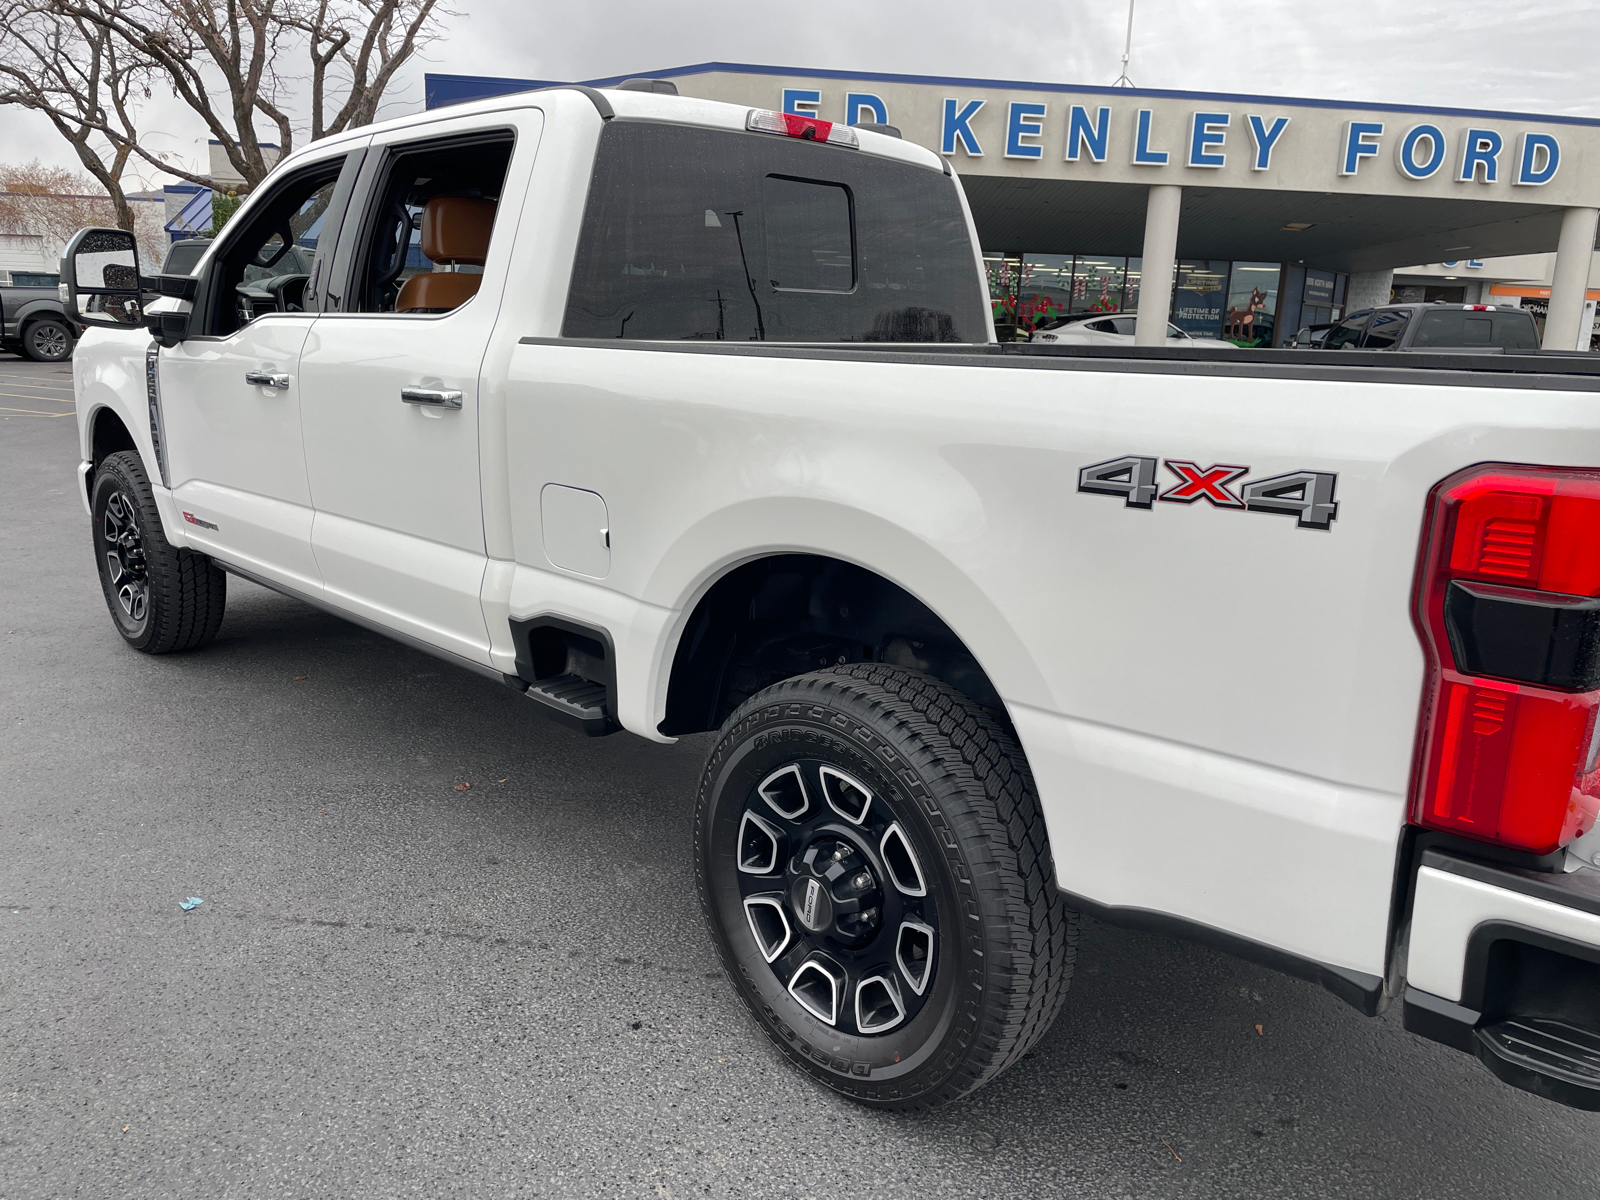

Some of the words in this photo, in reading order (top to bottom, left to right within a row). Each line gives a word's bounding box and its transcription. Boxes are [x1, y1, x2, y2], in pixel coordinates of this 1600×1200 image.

[941, 97, 1292, 172] KENLEY
[1339, 119, 1563, 188] FORD
[1056, 264, 1140, 301] CHRIST
[1178, 312, 1220, 321] PROTECTION
[1179, 307, 1210, 315] LIFETIME
[753, 727, 905, 803] BRIDGESTONE
[805, 885, 816, 923] FORD
[763, 1002, 872, 1078] DUELER
